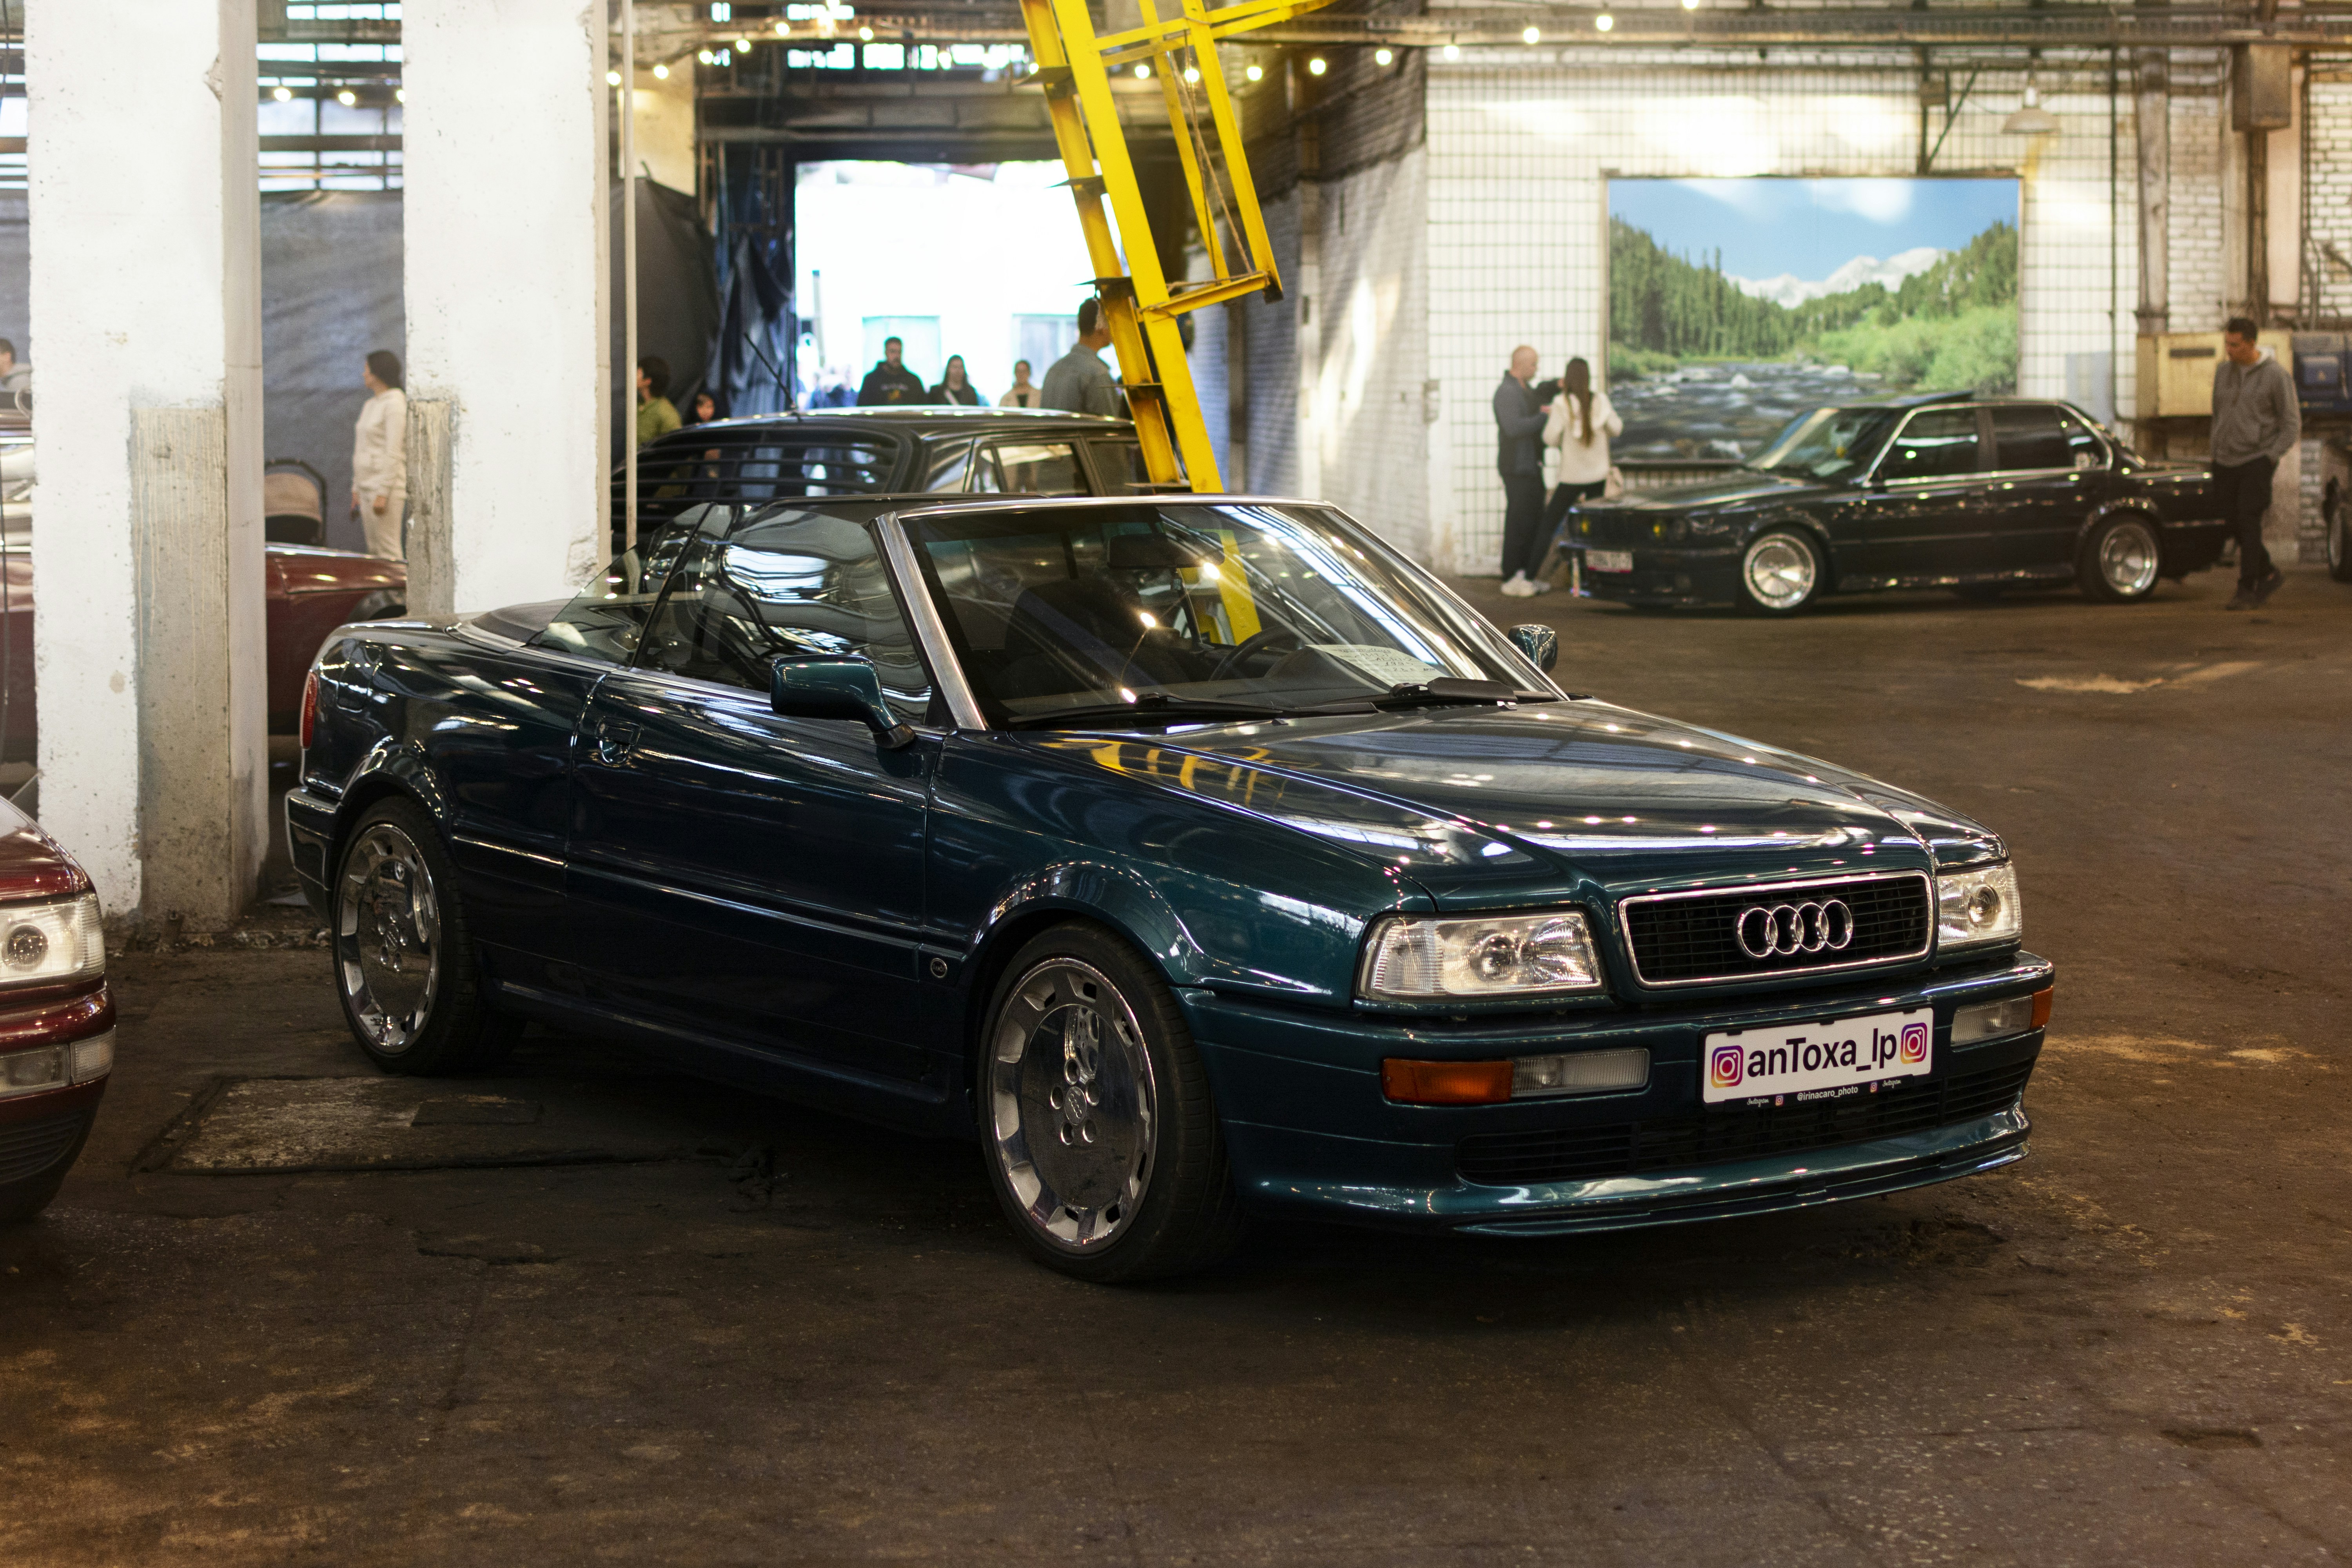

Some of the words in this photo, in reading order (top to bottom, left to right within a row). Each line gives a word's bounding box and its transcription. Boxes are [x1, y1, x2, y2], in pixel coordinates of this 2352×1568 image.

[1882, 1079, 1902, 1088] Instagram
[1797, 1085, 1858, 1102] @irinacaro_photo
[1747, 1098, 1769, 1107] Instagram
